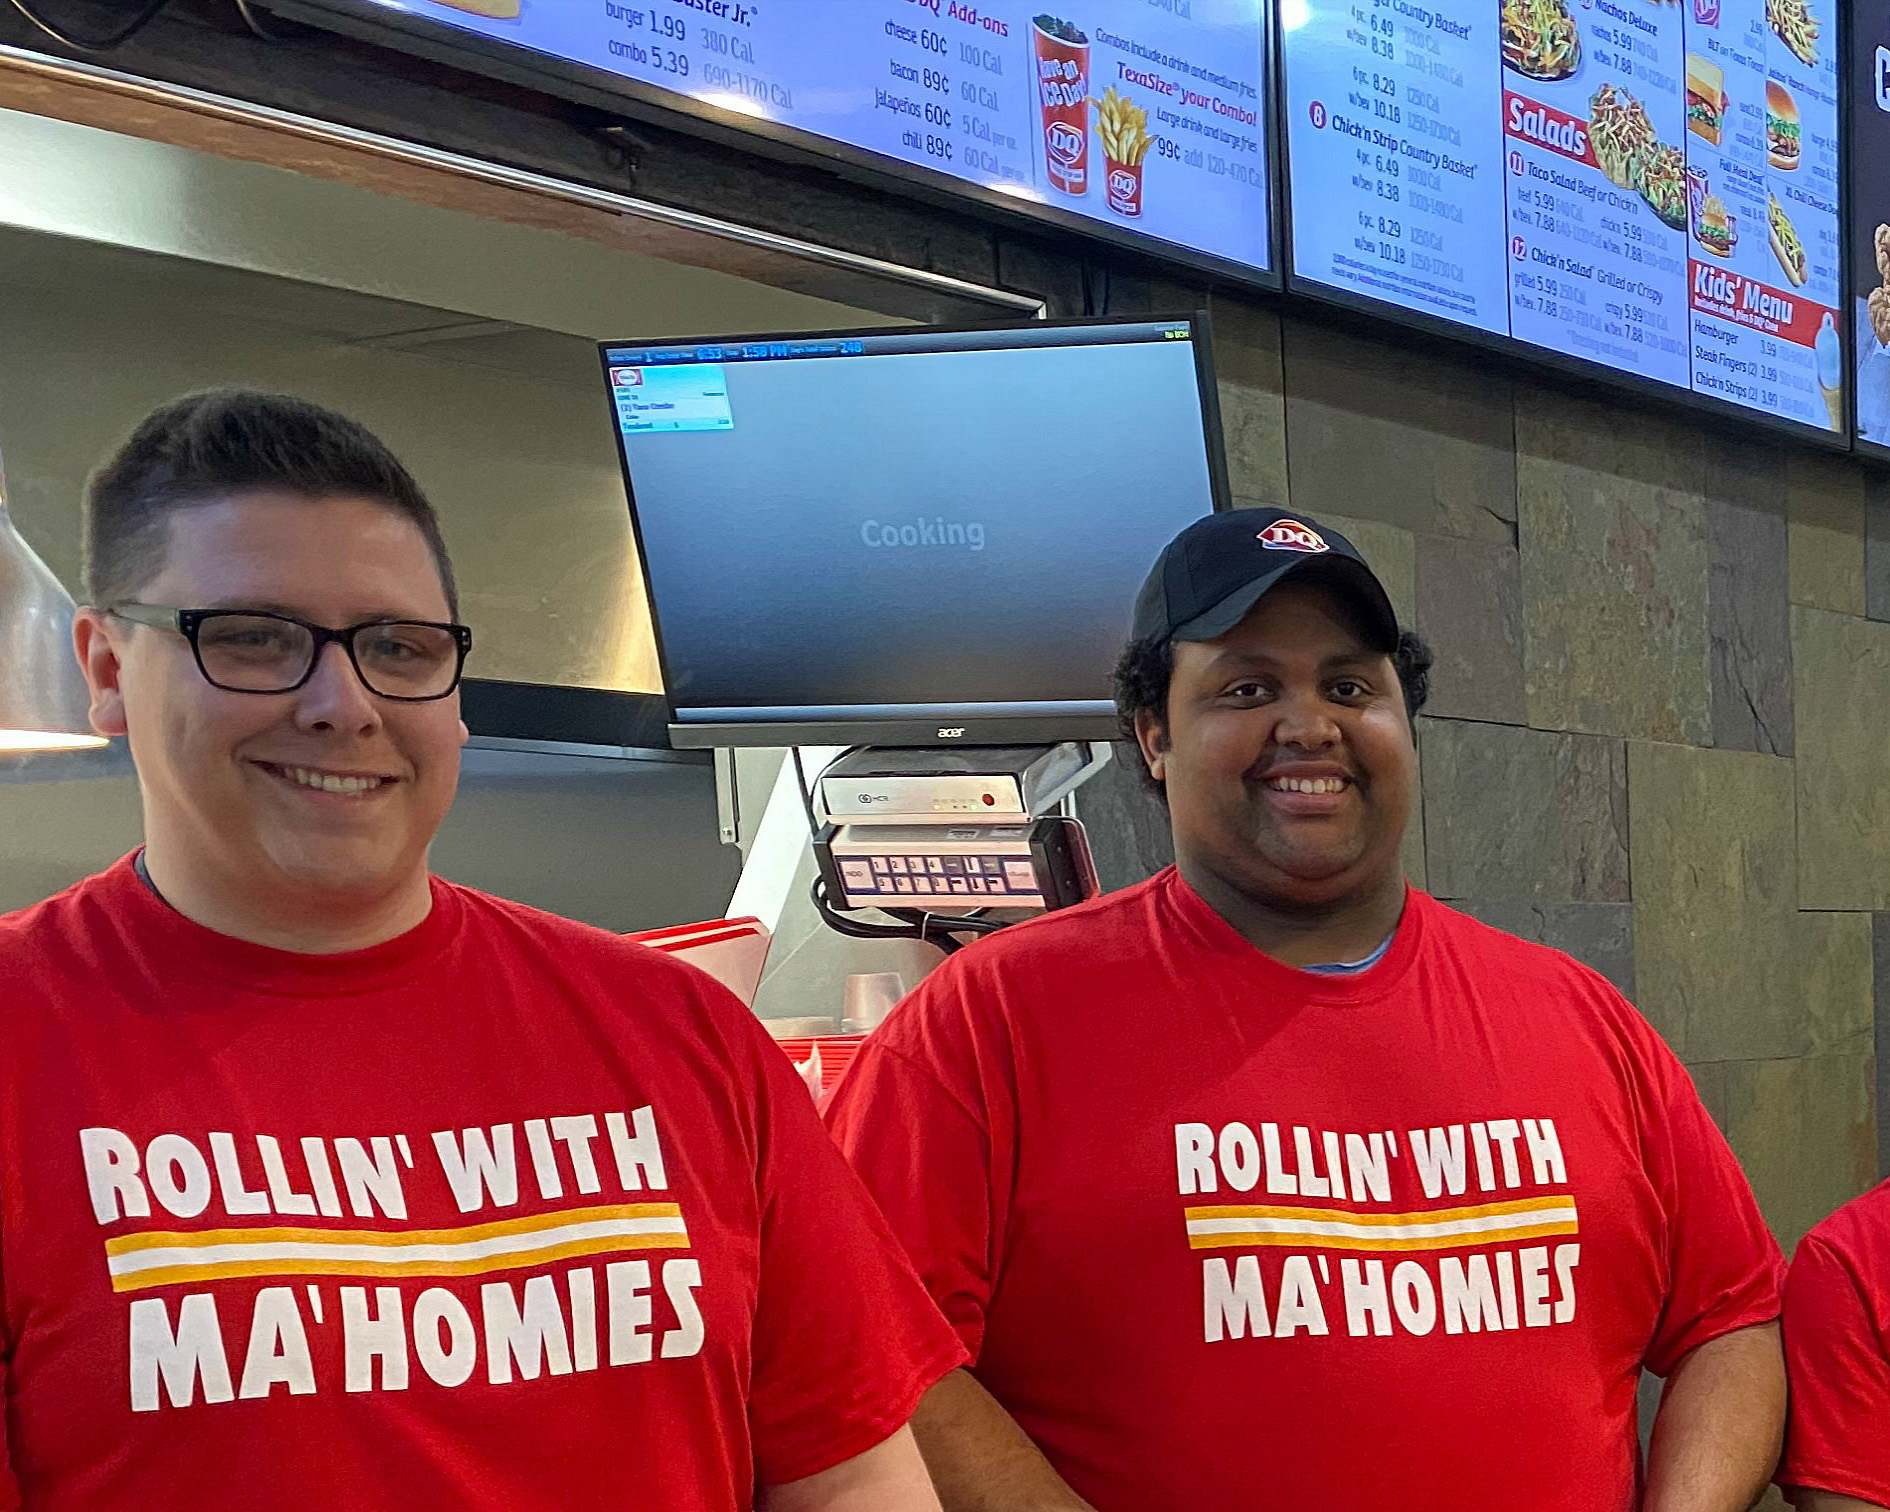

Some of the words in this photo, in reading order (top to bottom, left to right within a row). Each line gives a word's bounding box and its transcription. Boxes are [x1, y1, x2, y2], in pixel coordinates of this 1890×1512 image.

[948, 3, 1008, 37] Add-ons
[1370, 14, 1394, 37] 6.49
[1393, 0, 1434, 28] Country
[650, 10, 685, 41] 1.99
[700, 27, 727, 55] 380
[885, 18, 918, 44] cheese
[921, 29, 948, 56] 60¢
[960, 42, 980, 67] 100
[1371, 36, 1394, 60] 8.38
[1612, 29, 1632, 51] 5.99
[608, 39, 647, 63] combo
[651, 46, 689, 76] 5.39
[890, 58, 919, 84] bacon
[923, 68, 950, 95] 89¢
[1373, 73, 1396, 96] 8.29
[925, 103, 952, 129] 60¢
[1157, 106, 1181, 129] Large
[1180, 87, 1212, 110] your
[1212, 97, 1257, 126] Combo!
[1374, 98, 1400, 123] 10.18
[1332, 115, 1372, 142] Chick'n
[1372, 129, 1398, 154] Strip
[1399, 139, 1440, 170] Country
[1509, 97, 1586, 155] Salads
[926, 135, 953, 159] 89¢
[1158, 136, 1181, 162] 99¢
[1375, 155, 1399, 177] 6.49
[1527, 161, 1549, 182] Taco
[1550, 170, 1576, 192] Salad
[1578, 179, 1596, 204] Beef
[1377, 180, 1399, 202] 8.38
[1378, 216, 1400, 238] 8.29
[1534, 188, 1555, 211] 5.99
[1623, 222, 1642, 242] 5.99
[1379, 242, 1405, 264] 10.18
[1537, 276, 1557, 296] 5.99
[1624, 303, 1643, 323] 5.99
[1597, 269, 1626, 292] Grilled
[1637, 281, 1663, 305] Crispy
[1695, 264, 1741, 305] Kids'
[1743, 281, 1793, 325] Menu
[1695, 320, 1739, 345] Hamburger
[1760, 339, 1776, 357] 3.99
[1695, 346, 1717, 365] Steak
[1719, 352, 1747, 373] Fingers
[1761, 365, 1777, 382] 3.99
[1725, 381, 1747, 400] Strips
[1761, 391, 1778, 407] 3.99
[860, 515, 986, 552] Cooking
[937, 727, 965, 739] acer
[79, 1127, 414, 1226] ROLLIN'
[431, 1104, 668, 1214] WITH
[1174, 1121, 1398, 1203] ROLLIN'
[1408, 1118, 1568, 1199] WITH
[1203, 1243, 1581, 1344] MA'HOMIES
[130, 1258, 706, 1413] MA'HOMIES
